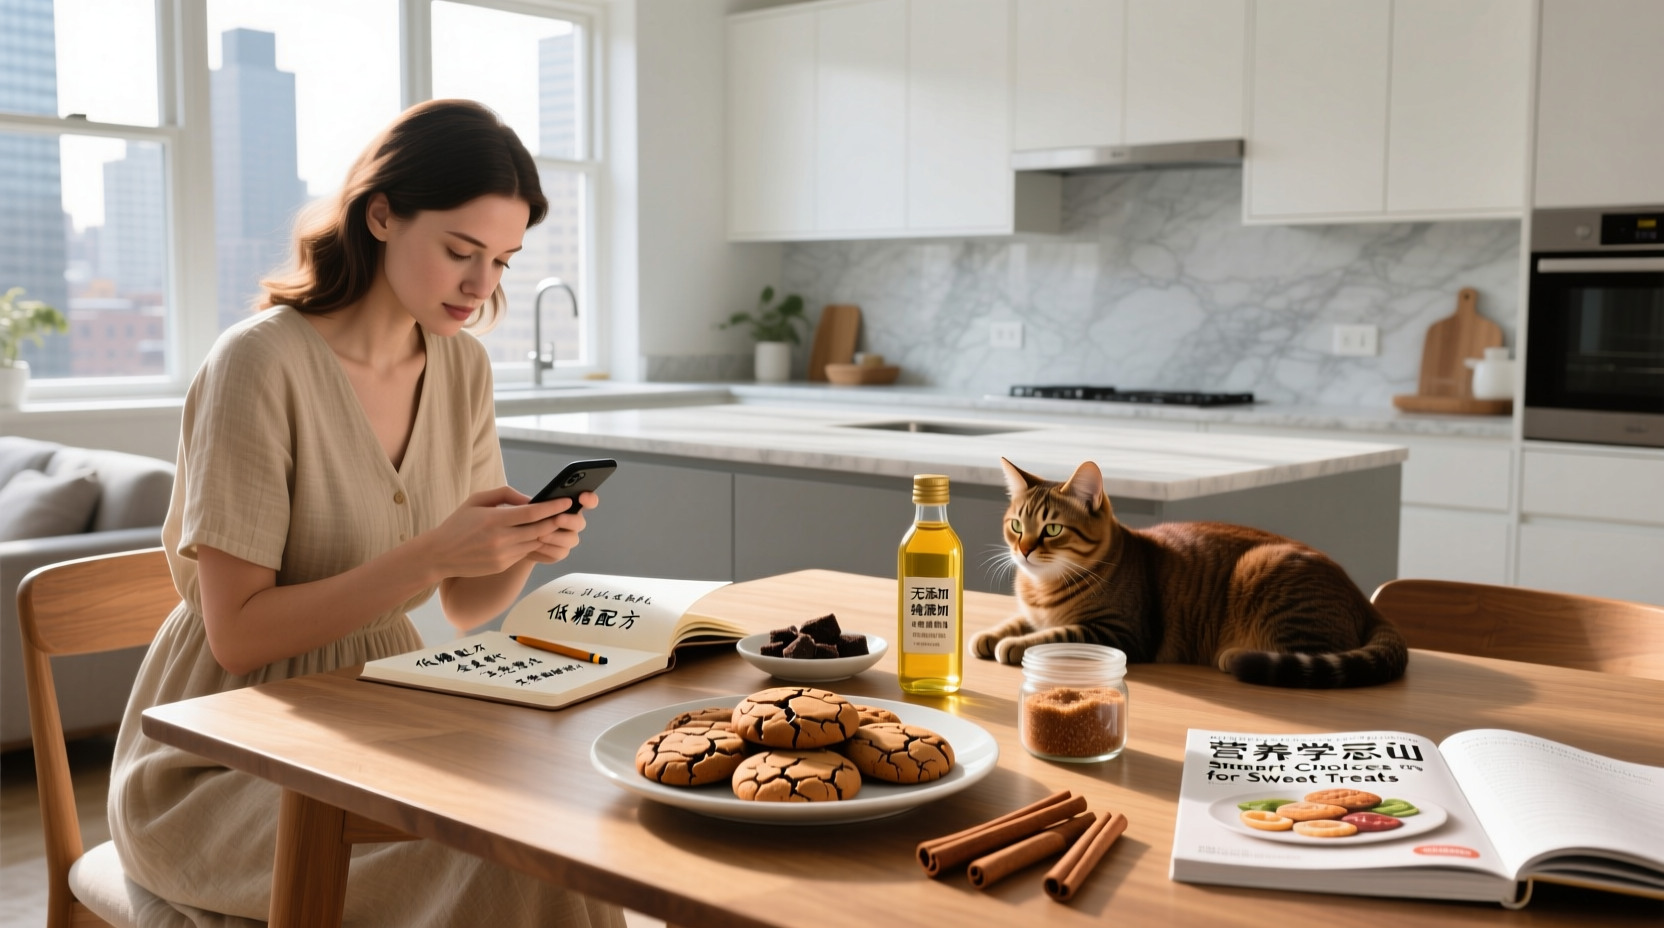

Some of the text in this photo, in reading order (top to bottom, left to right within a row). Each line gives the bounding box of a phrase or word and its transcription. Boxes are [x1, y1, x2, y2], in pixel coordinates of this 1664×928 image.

[547, 603, 640, 630] 低糖配方
[1207, 770, 1240, 782] for
[1325, 772, 1399, 784] Treats
